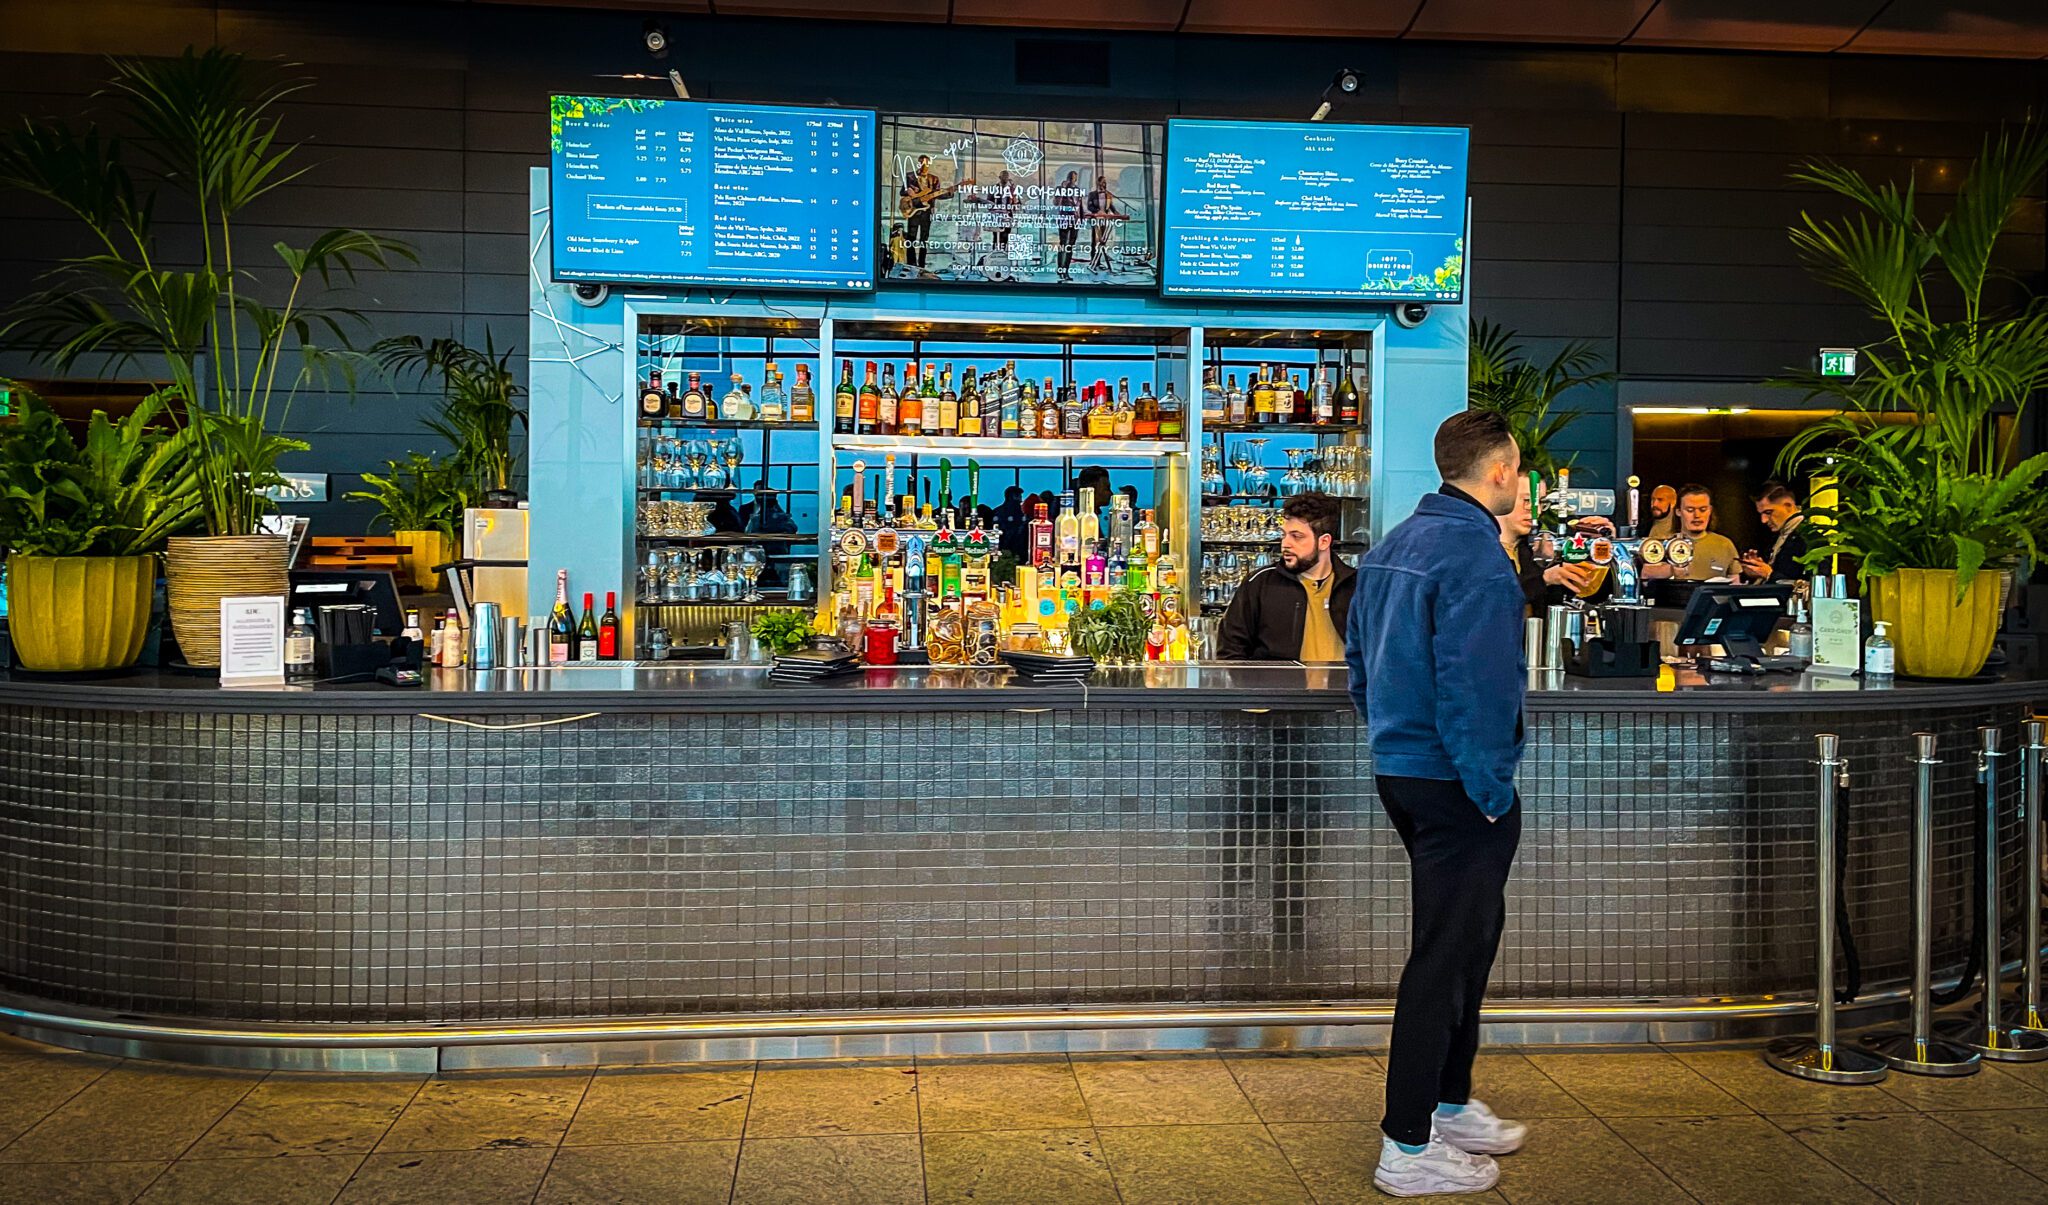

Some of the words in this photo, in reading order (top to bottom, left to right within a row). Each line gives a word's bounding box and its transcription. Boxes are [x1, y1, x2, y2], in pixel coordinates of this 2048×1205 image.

[958, 185, 978, 194] LIVE
[1049, 188, 1086, 197] GARDEN
[930, 214, 948, 222] NEW
[1091, 219, 1123, 227] DINING
[1180, 234, 1211, 242] Sparkling
[900, 240, 940, 249] LOCATED
[943, 241, 986, 250] OPPOSITE
[1080, 245, 1092, 253] TO
